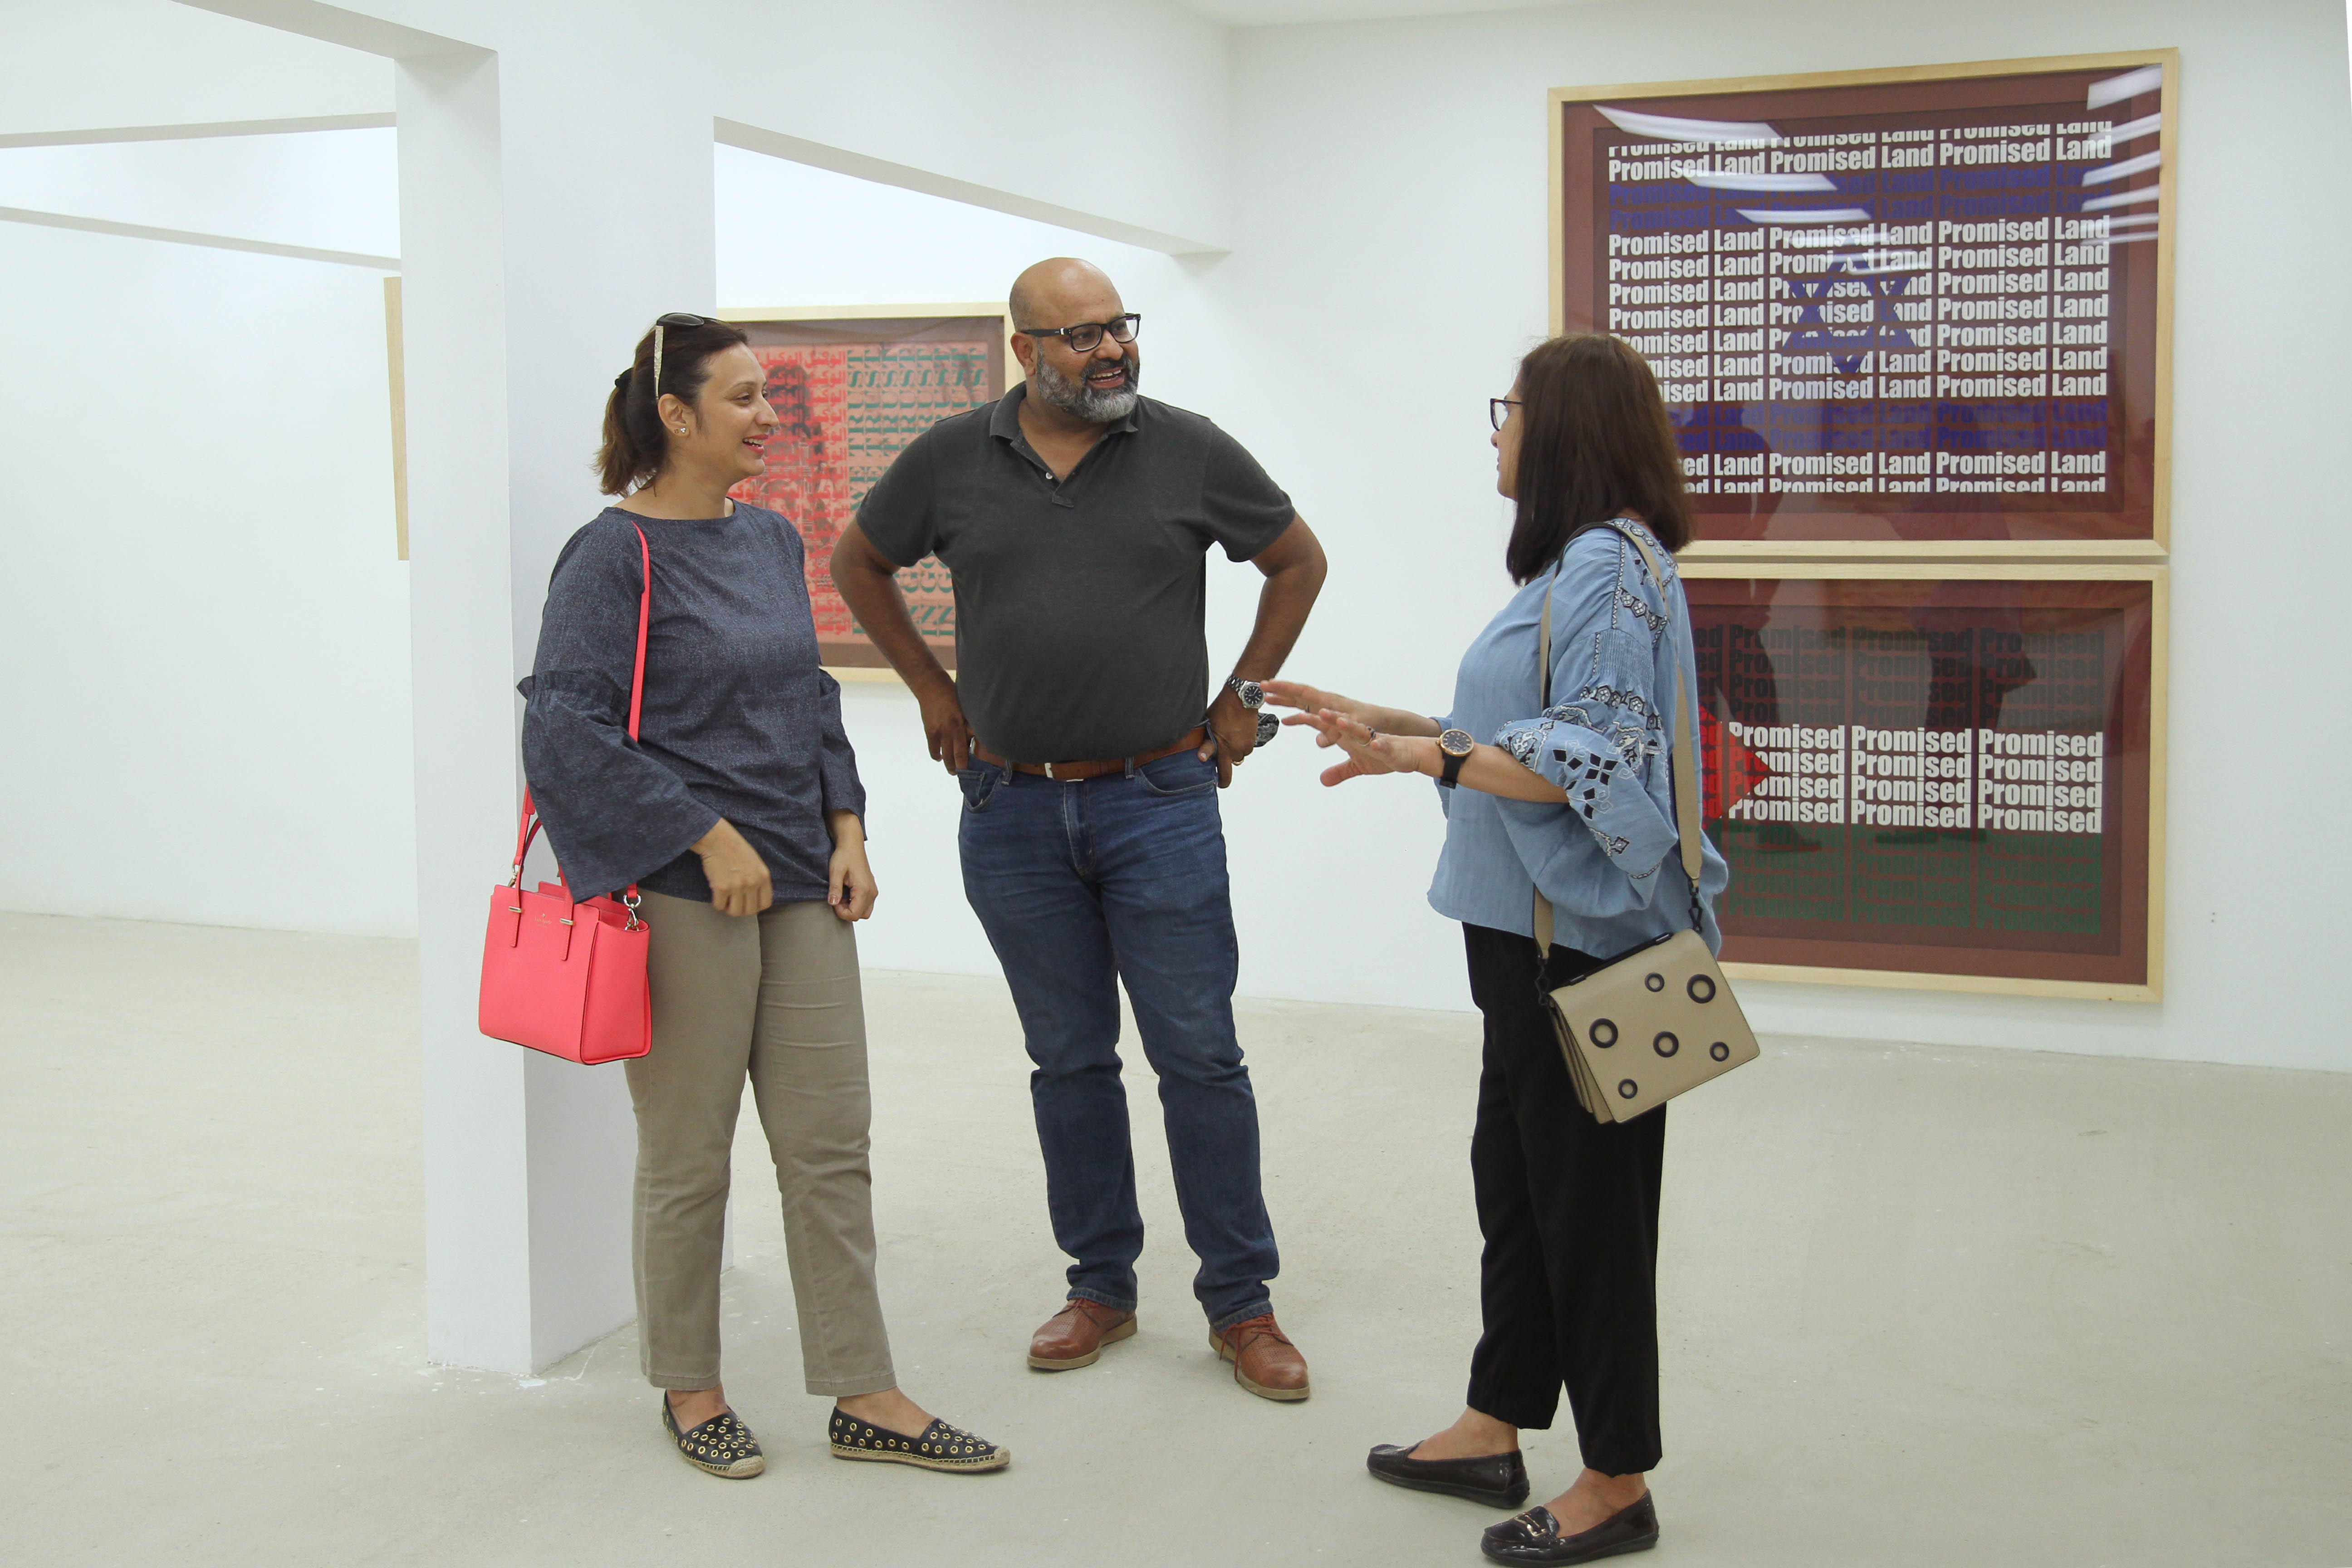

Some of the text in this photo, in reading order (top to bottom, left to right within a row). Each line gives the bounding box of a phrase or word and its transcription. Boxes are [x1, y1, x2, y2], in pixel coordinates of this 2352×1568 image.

[1609, 134, 2110, 181] Promised Land Promised Land Promised Land
[1610, 181, 1710, 206] Promised
[1882, 170, 1934, 194] Land
[1940, 164, 2049, 192] Promised
[1610, 206, 1710, 231] Promised
[1881, 196, 1933, 220] Land
[1940, 191, 2049, 218] Promised
[1609, 214, 2109, 255] Promised Land Promised Land Promised Land
[1609, 255, 1708, 280] Promised
[1714, 253, 1764, 277] Land
[1880, 247, 1932, 271] Land
[1938, 243, 2048, 269] Promised
[2054, 240, 2108, 265] Land
[1609, 267, 2108, 305] Promised Land Promised Land Promised Land
[1609, 293, 2107, 329] Promised Land Promised Land Promised Land
[1617, 319, 2107, 354] omised Land Promised Land Promised Land
[951, 348, 968, 409] UST
[969, 347, 986, 408] UST
[1645, 346, 2107, 378] mised Land Promised Land Promised Land
[864, 350, 881, 456] TRUST
[881, 349, 899, 456] TRUST
[916, 348, 933, 433] RUST
[934, 348, 951, 420] UST
[1714, 379, 1763, 401] Land
[1769, 377, 1873, 400] Promised
[1879, 376, 1931, 398] Land
[1937, 373, 2046, 397] Promised
[2052, 372, 2106, 396] Land
[1715, 404, 1764, 426] Land
[1770, 402, 1874, 426] Promised
[1880, 402, 1931, 424] Land
[1938, 400, 2046, 423] Promised
[2053, 399, 2107, 422] Land
[1715, 429, 1764, 451] Land
[1770, 428, 1873, 451] Promised
[1880, 427, 1931, 450] Land
[1937, 426, 2046, 449] Promised
[2052, 425, 2107, 448] Land
[1714, 454, 1763, 475] Land
[1769, 453, 1872, 475] Promised
[1878, 452, 1930, 474] Land
[1936, 451, 2045, 474] Promised
[2051, 451, 2105, 473] Land
[1769, 478, 1872, 493] Promised
[1936, 477, 2044, 492] Promised
[1729, 723, 1845, 750] Promised
[1852, 726, 1971, 753] Promised
[1979, 729, 2102, 757] Promised
[1729, 747, 1844, 774] Promised
[1852, 750, 1971, 778] Promised
[1979, 754, 2102, 782] Promised
[1729, 771, 1844, 799] Promised
[1852, 775, 1971, 803] Promised
[1979, 779, 2102, 808] Promised
[1729, 795, 1844, 823] Promised
[1852, 800, 1971, 828] Promised
[1978, 804, 2102, 833] Promised
